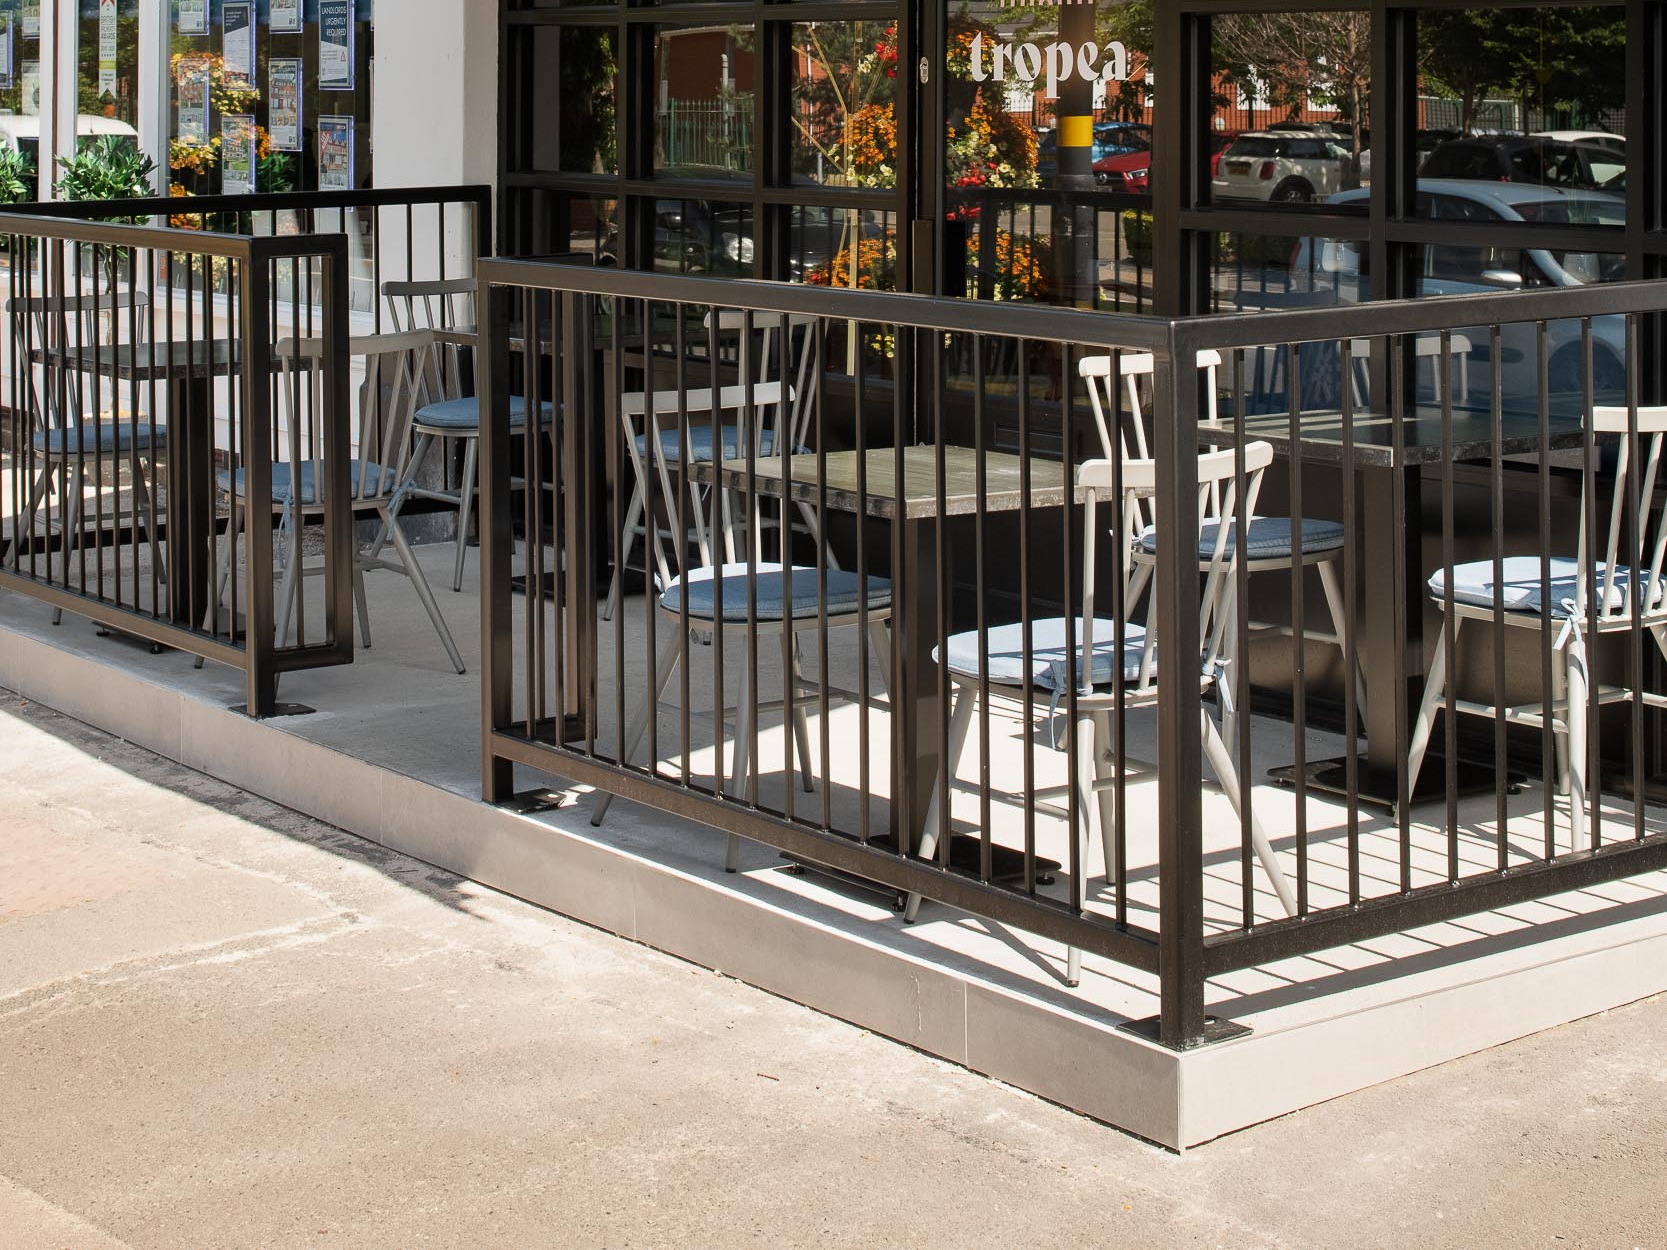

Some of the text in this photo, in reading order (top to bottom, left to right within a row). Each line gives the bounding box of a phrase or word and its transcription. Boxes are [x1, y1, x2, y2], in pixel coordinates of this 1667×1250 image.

[321, 6, 347, 15] LANDLORDS
[325, 17, 347, 26] URGENTLY
[326, 28, 347, 37] REQUIRED
[969, 31, 1129, 99] tropea
